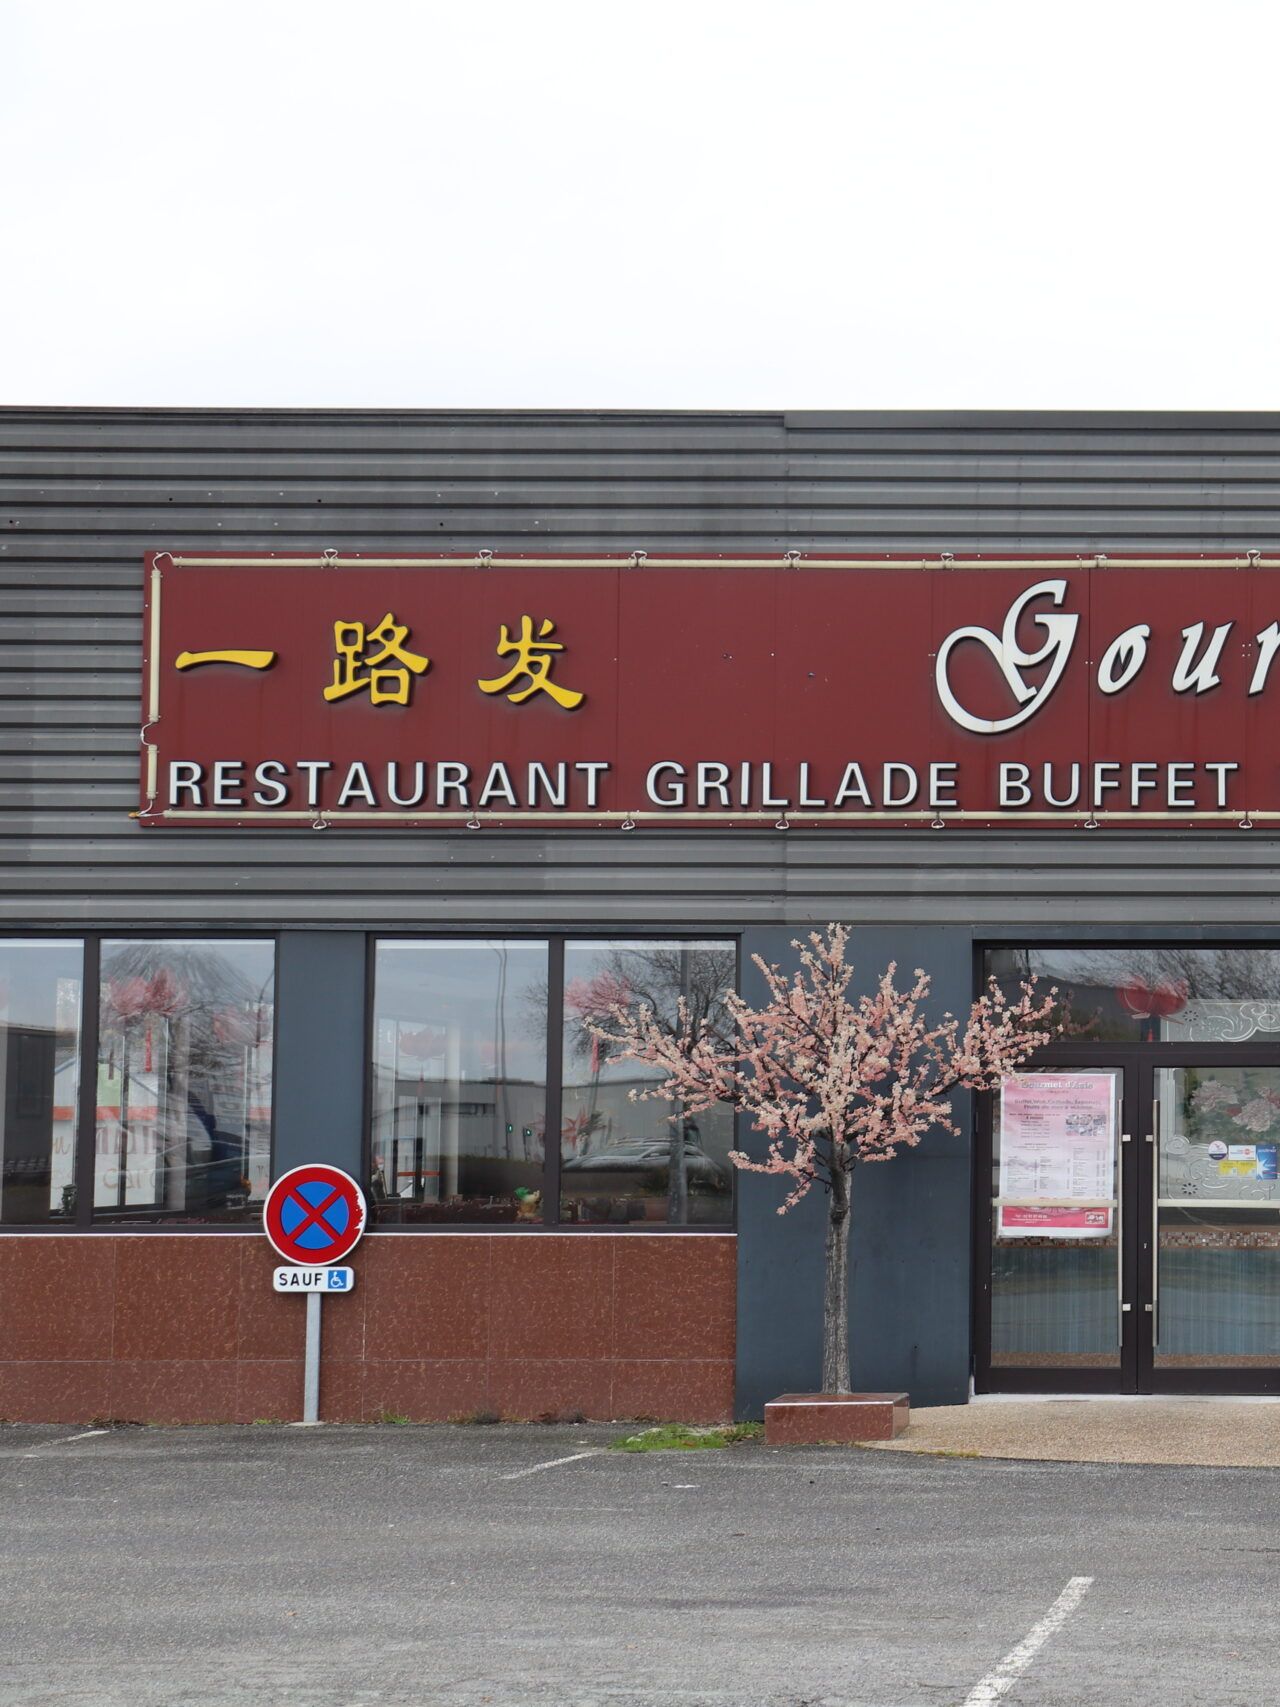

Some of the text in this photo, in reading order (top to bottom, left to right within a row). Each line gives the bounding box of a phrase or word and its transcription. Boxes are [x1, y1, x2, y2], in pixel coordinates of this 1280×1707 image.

[174, 612, 584, 710] 一路发
[168, 762, 609, 806] RESTAURANT
[645, 762, 958, 806] GRILLADE
[998, 762, 1239, 806] BUFFET
[278, 1272, 323, 1287] SAUF
